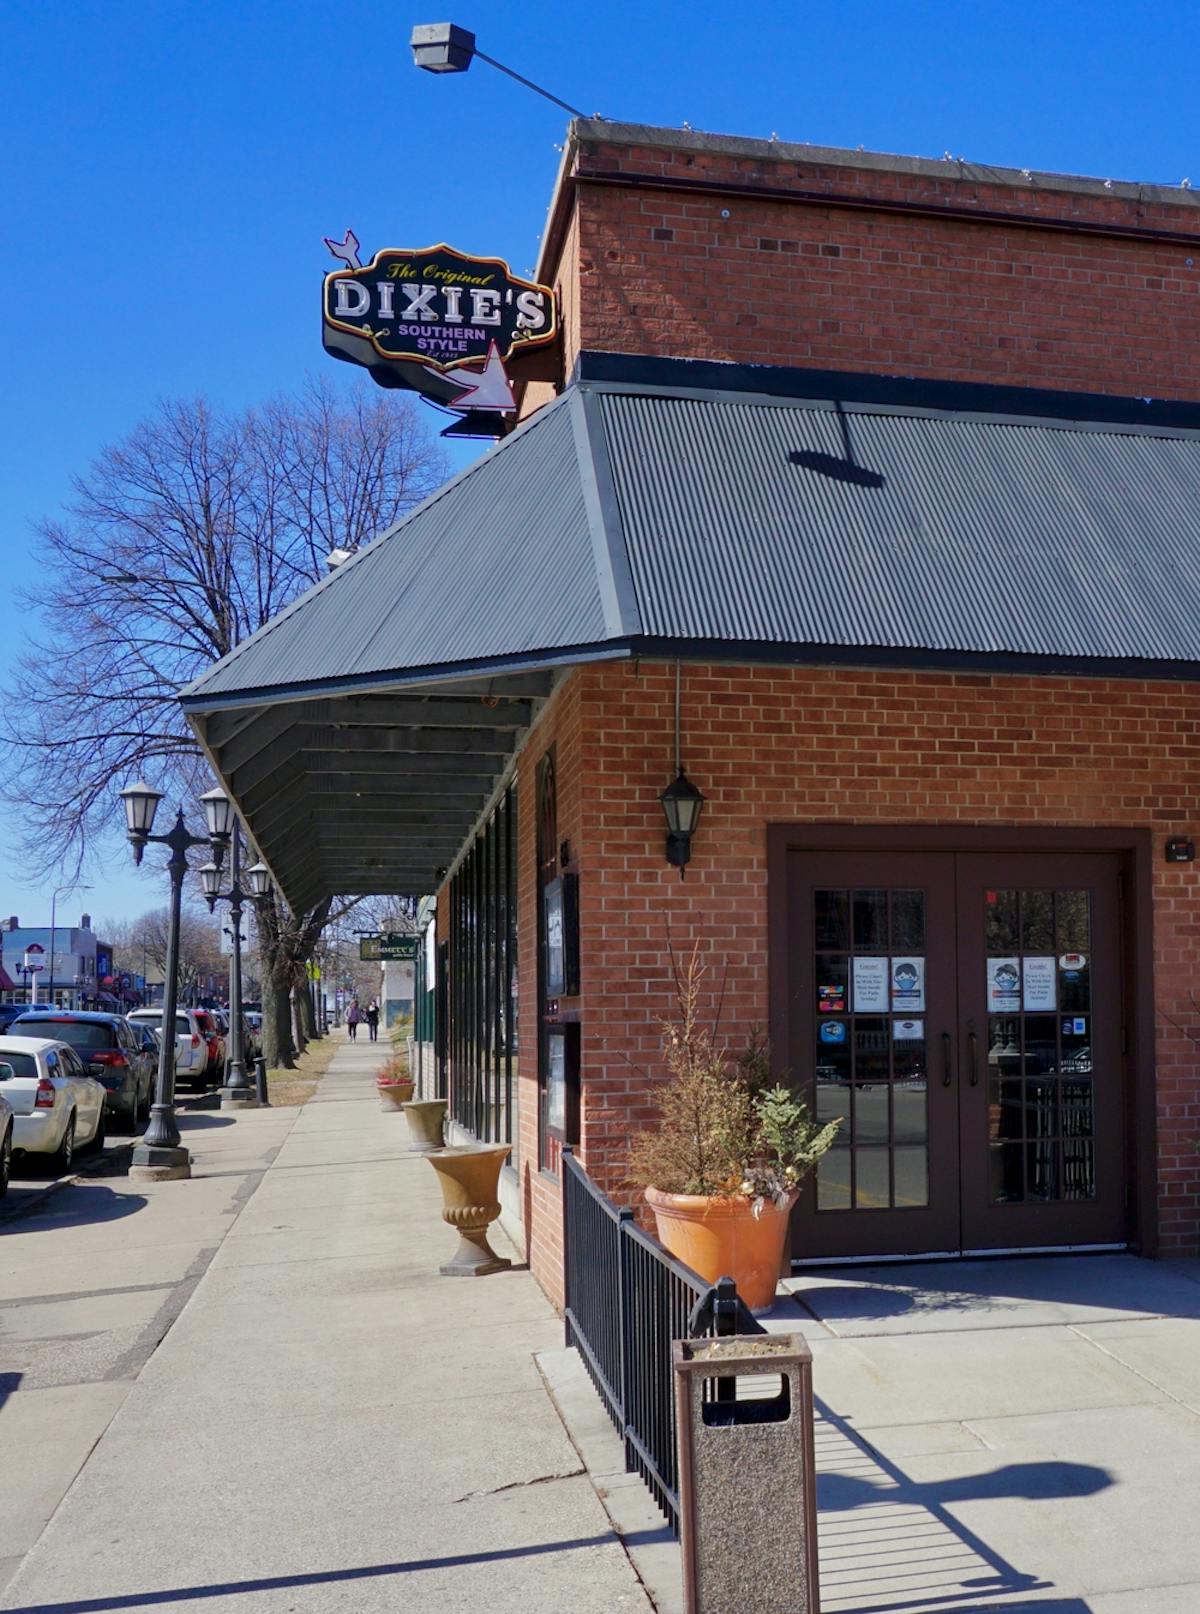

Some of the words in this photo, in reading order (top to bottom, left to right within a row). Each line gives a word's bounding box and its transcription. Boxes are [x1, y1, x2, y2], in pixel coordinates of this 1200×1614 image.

[386, 263, 417, 279] The
[422, 264, 496, 285] Original
[334, 279, 545, 329] DIXIE'S
[398, 324, 486, 340] SOUTHERN
[417, 338, 468, 352] STYLE
